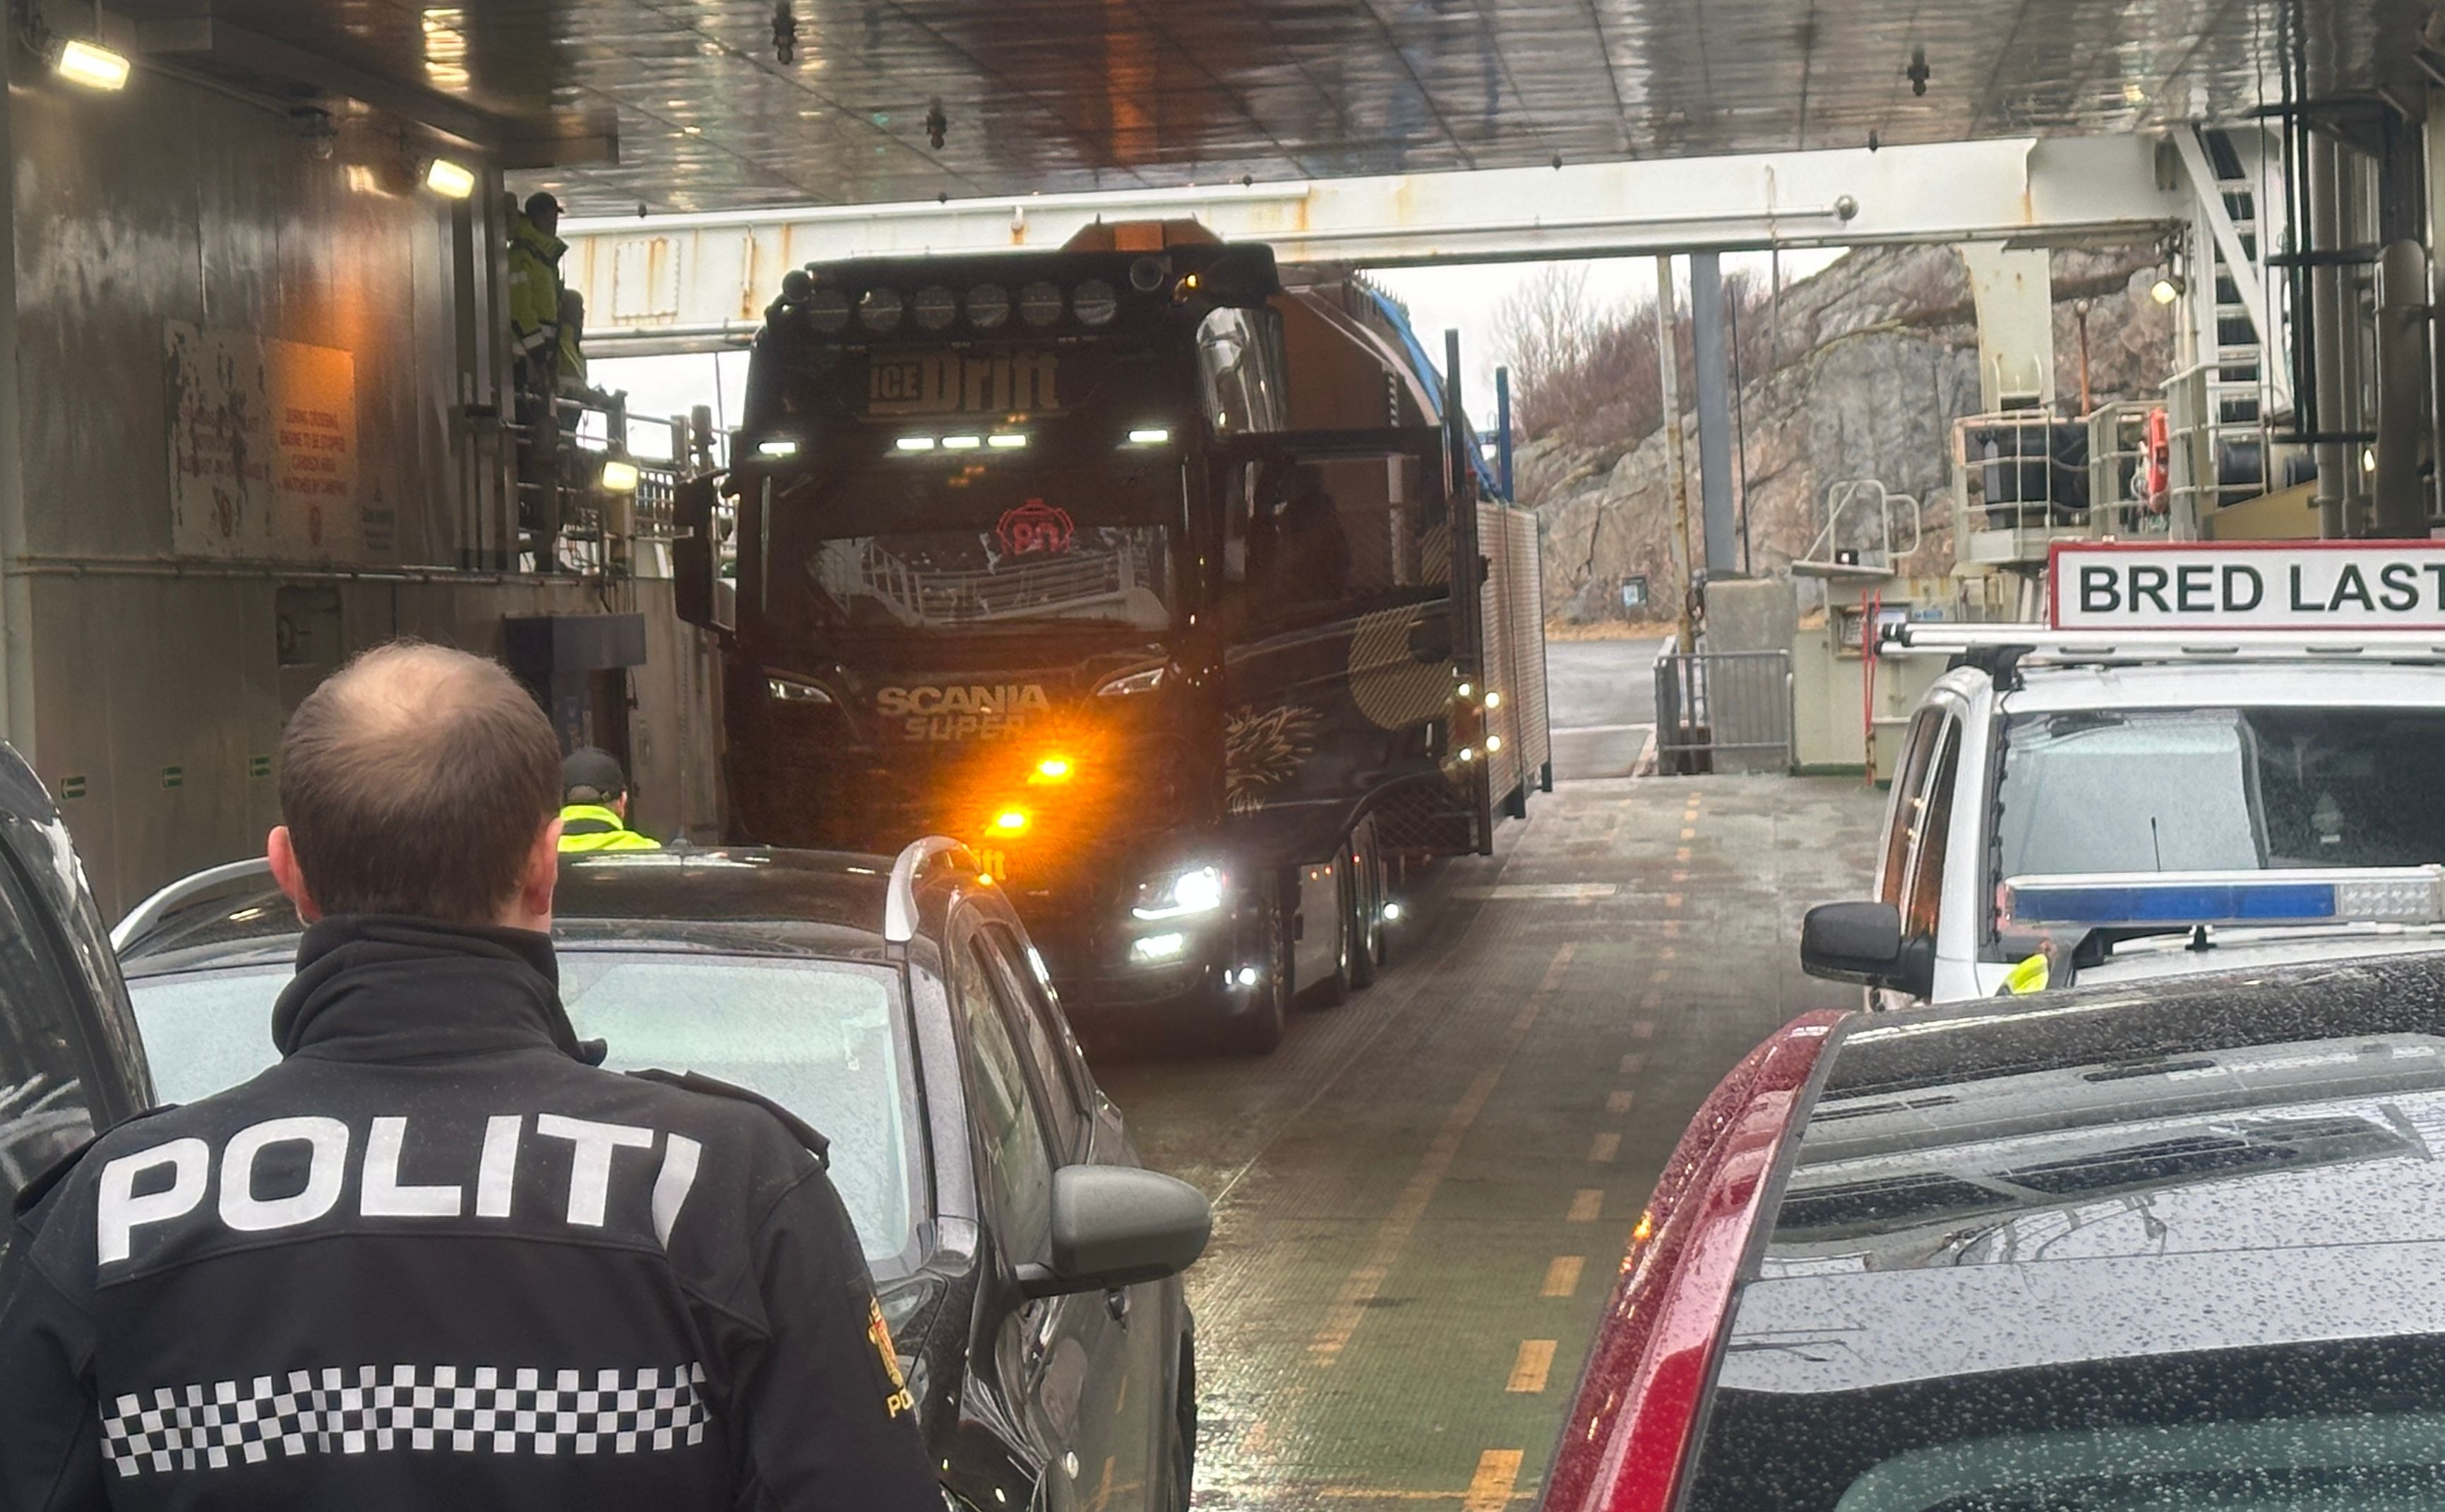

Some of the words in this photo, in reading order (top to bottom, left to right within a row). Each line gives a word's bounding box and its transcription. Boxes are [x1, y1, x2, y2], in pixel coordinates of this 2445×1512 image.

[869, 363, 919, 398] ICE
[921, 353, 1060, 412] Drift
[2079, 565, 2264, 613] BRED
[876, 685, 1051, 716] SCANIA
[904, 715, 1025, 740] SUPER
[97, 1113, 702, 1266] POLITI
